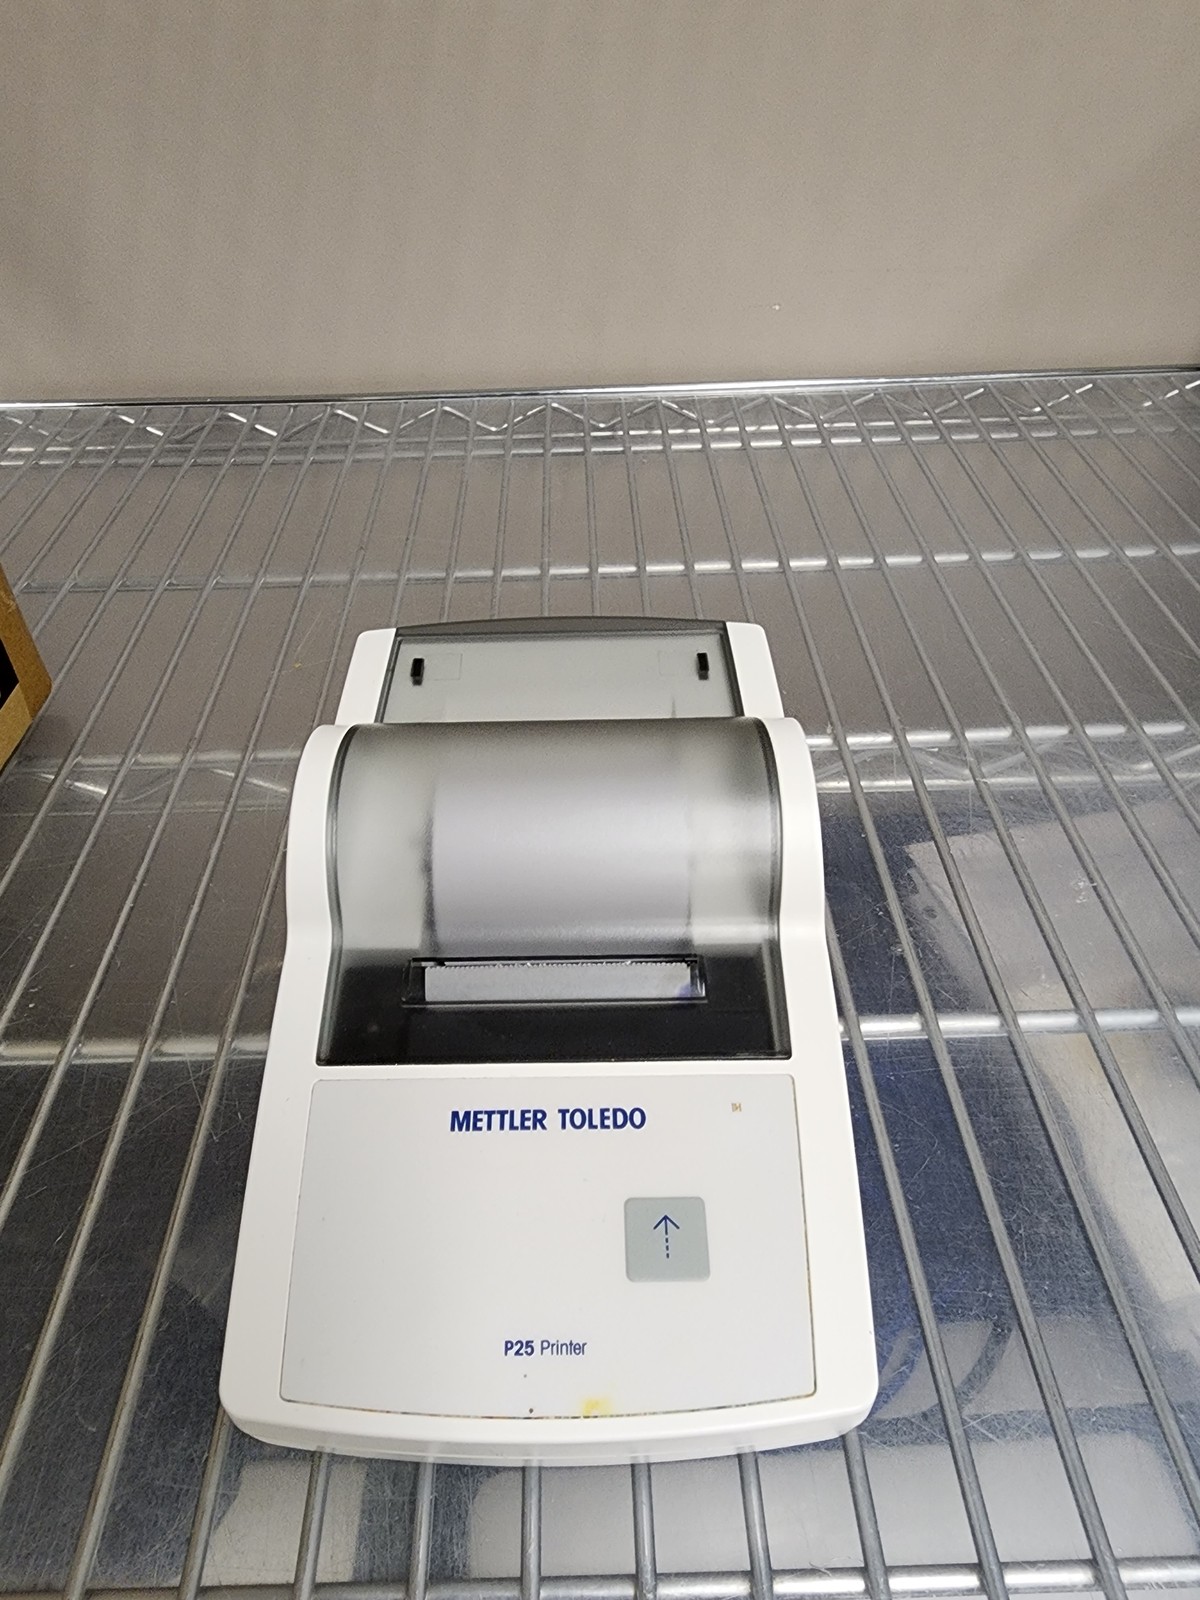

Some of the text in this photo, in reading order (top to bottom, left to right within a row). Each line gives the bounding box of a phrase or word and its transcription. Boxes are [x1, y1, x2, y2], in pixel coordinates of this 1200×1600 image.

[450, 1107, 647, 1132] METTLER TOLEDO
[503, 1339, 588, 1357] P25 Printer
